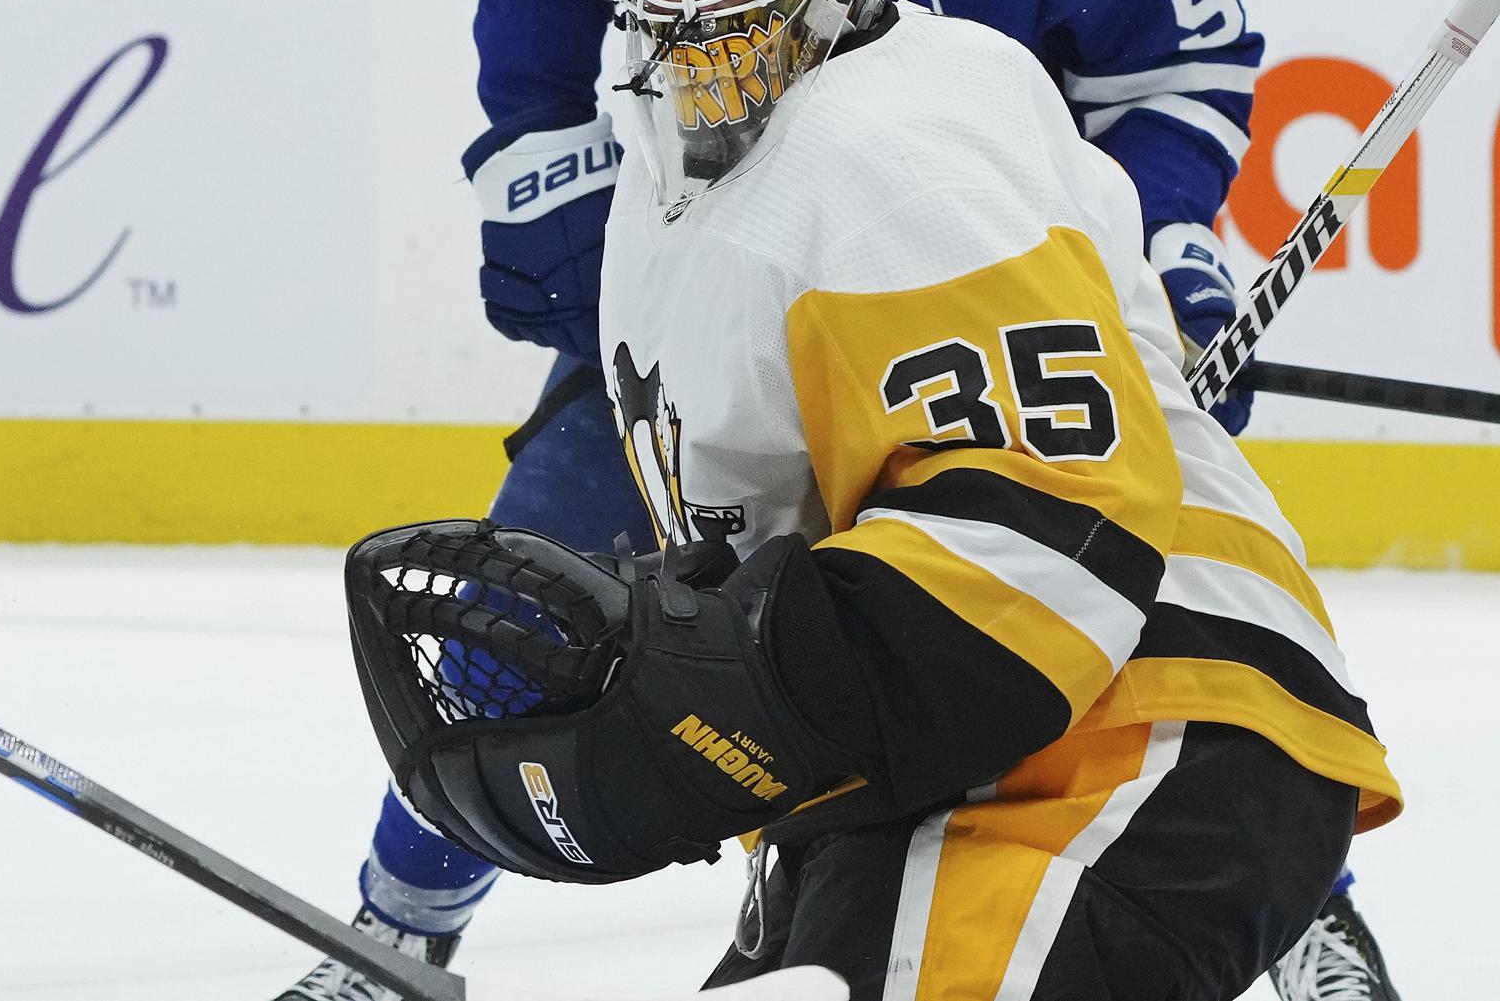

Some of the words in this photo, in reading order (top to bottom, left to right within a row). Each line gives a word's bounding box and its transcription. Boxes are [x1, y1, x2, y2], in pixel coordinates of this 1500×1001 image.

[126, 278, 177, 309] TM
[878, 318, 1122, 464] 35
[669, 713, 789, 801] VAUGHN
[730, 730, 777, 764] JARRY
